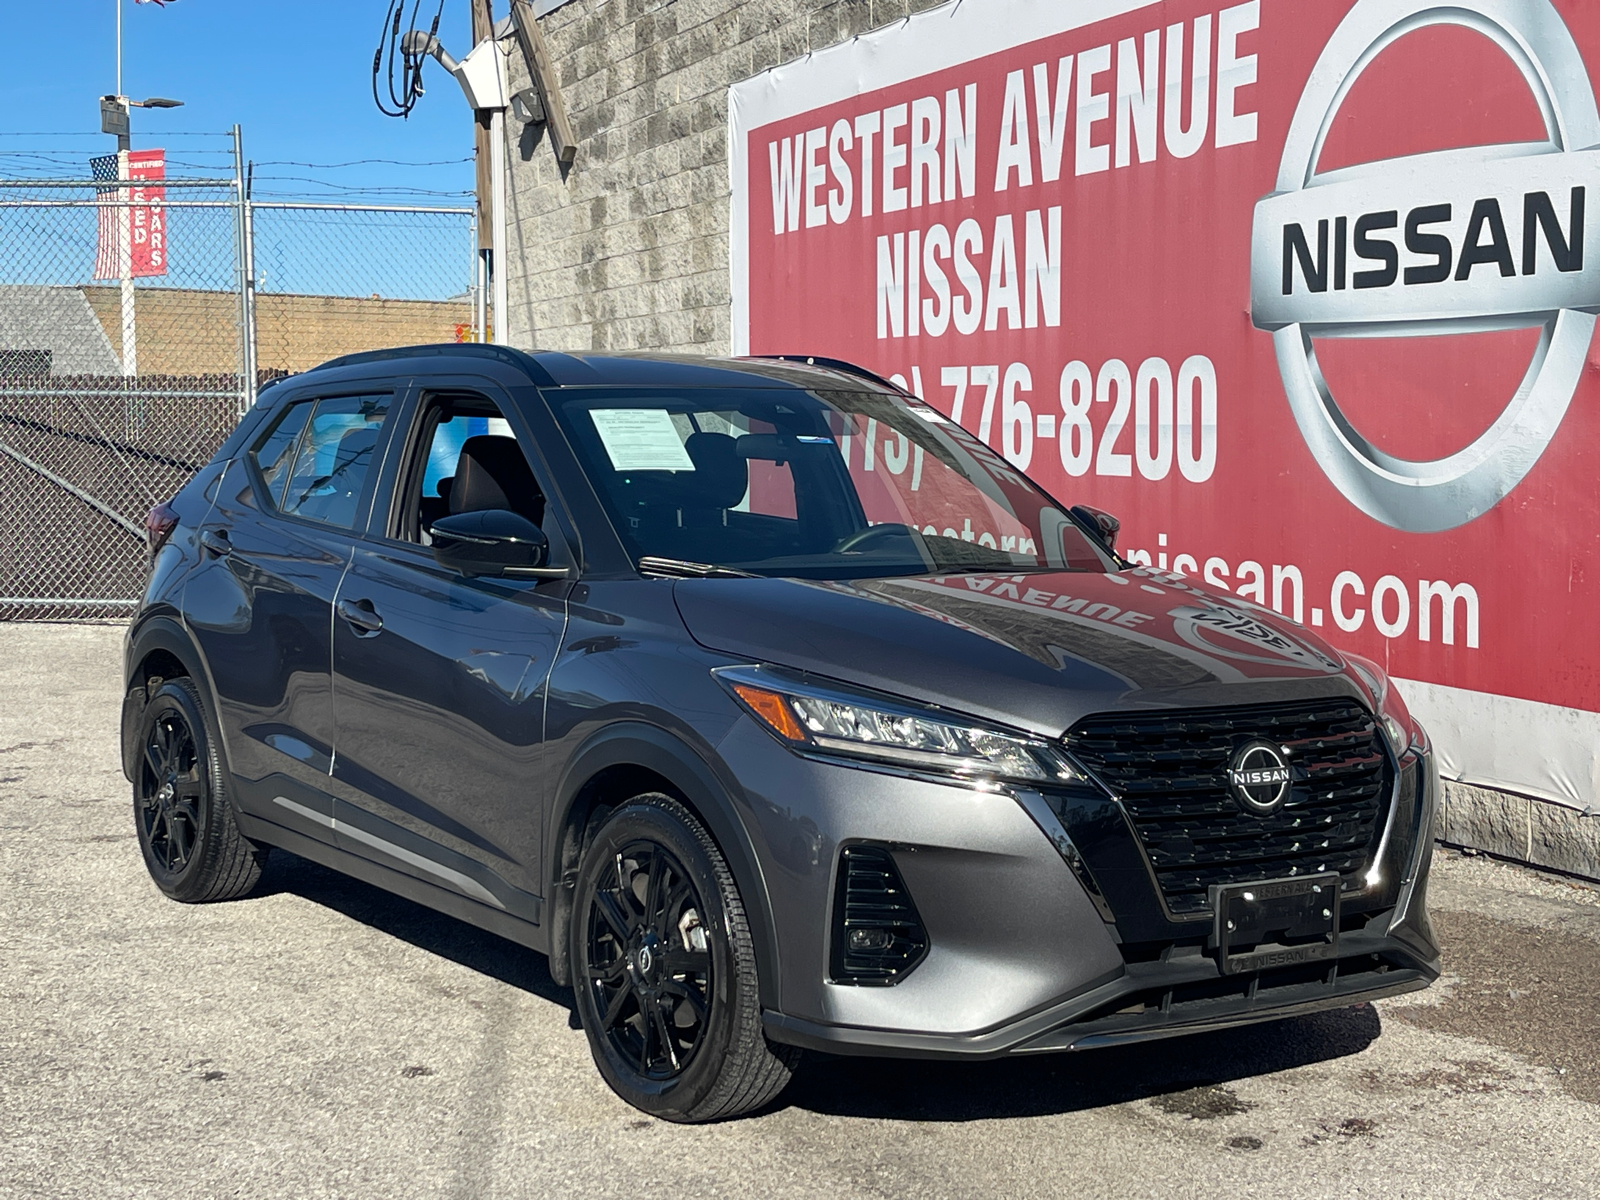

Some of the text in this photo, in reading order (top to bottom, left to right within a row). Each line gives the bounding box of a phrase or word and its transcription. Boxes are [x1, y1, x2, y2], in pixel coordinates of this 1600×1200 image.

[769, 0, 1261, 236] WESTERN AVENUE
[876, 205, 1063, 340] NISSAN
[1282, 186, 1586, 296] NISSAN
[941, 354, 1218, 484] 776-8200
[1233, 768, 1290, 785] NISSAN
[1256, 950, 1306, 968] NISSAN
